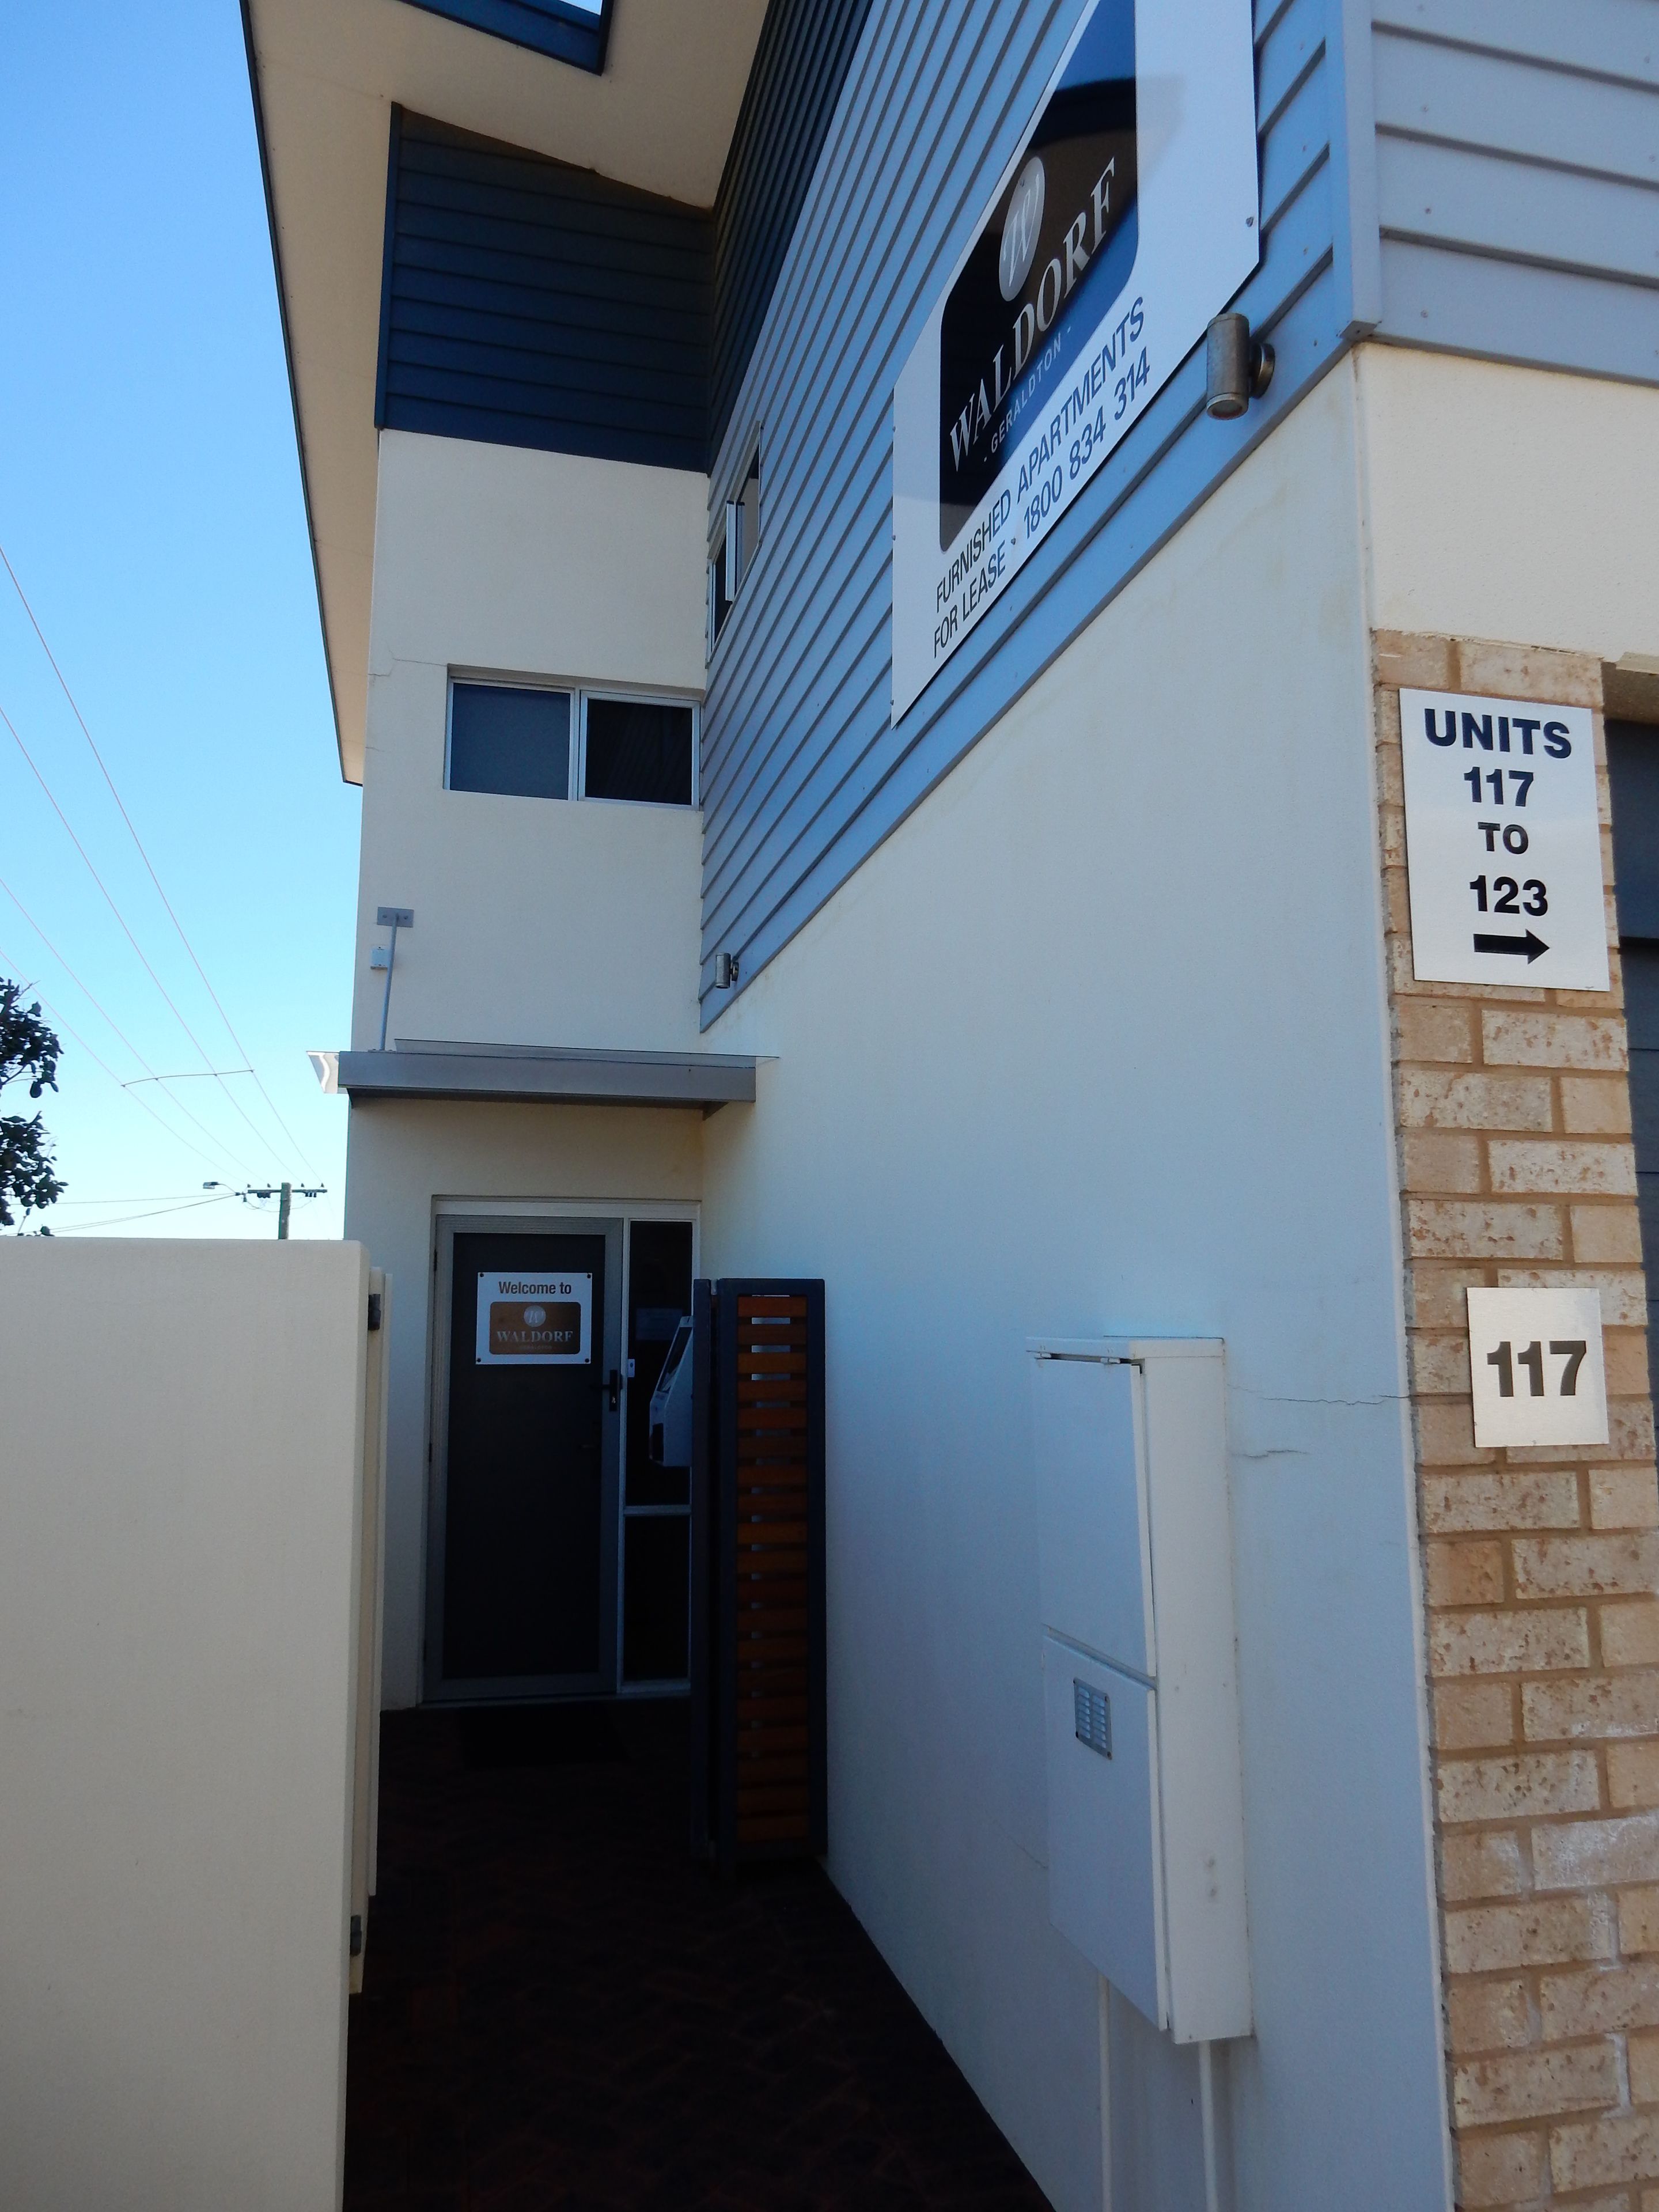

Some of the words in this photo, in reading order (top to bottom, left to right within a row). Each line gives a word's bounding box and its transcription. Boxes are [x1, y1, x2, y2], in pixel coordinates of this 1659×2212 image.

[949, 157, 1116, 472] WALDORF
[990, 343, 1063, 454] GERALDTON
[936, 488, 1012, 613] FURNISHED
[1016, 296, 1145, 503] APARTMENTS
[934, 604, 958, 660] FOR
[962, 539, 1006, 622] LEASE
[1023, 465, 1063, 540] 1800
[1069, 404, 1107, 480] 834
[1113, 346, 1151, 422] 314
[1424, 707, 1573, 760] UNITS
[1464, 766, 1535, 808] 117
[1478, 821, 1529, 855] TO
[1469, 874, 1549, 917] 123
[498, 1281, 556, 1295] Welcome
[559, 1281, 572, 1295] to
[496, 1330, 574, 1343] WALDORF
[1486, 1339, 1587, 1397] 117
